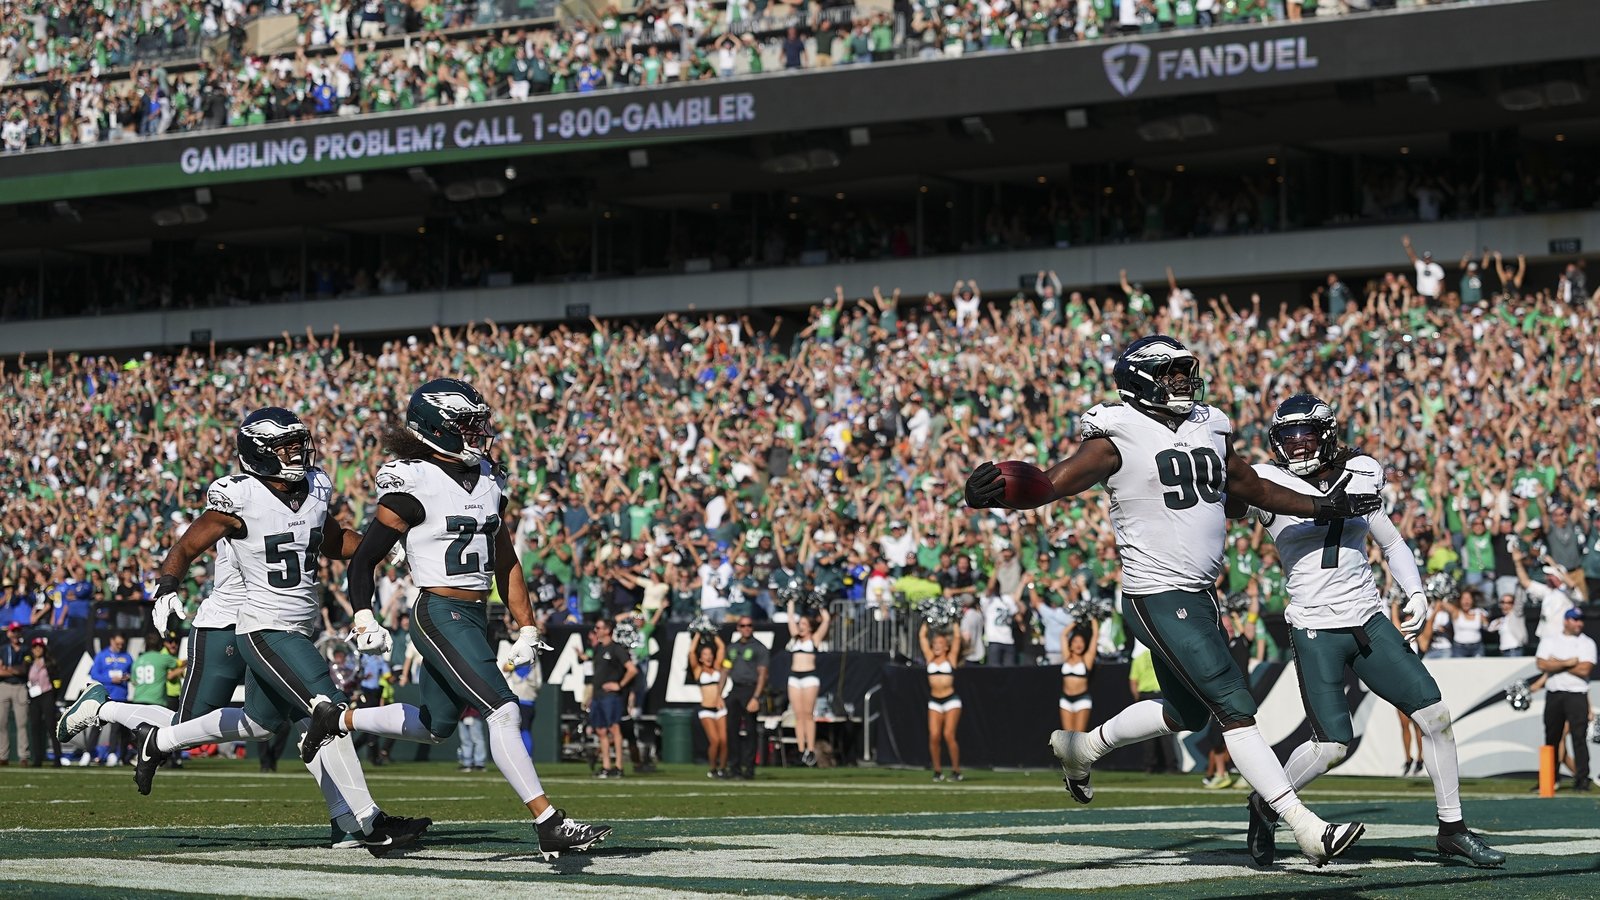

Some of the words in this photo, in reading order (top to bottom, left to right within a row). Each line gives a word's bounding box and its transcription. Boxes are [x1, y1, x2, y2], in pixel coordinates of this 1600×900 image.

[1158, 37, 1319, 81] FANDUEL
[180, 137, 308, 174] GAMBLING
[314, 123, 447, 162] PROBLEM?
[453, 116, 523, 148] CALL
[531, 93, 755, 141] 1-800-GAMBLER
[1155, 447, 1222, 510] 90
[264, 527, 321, 588] 54
[445, 514, 500, 576] 21
[136, 665, 155, 684] 98
